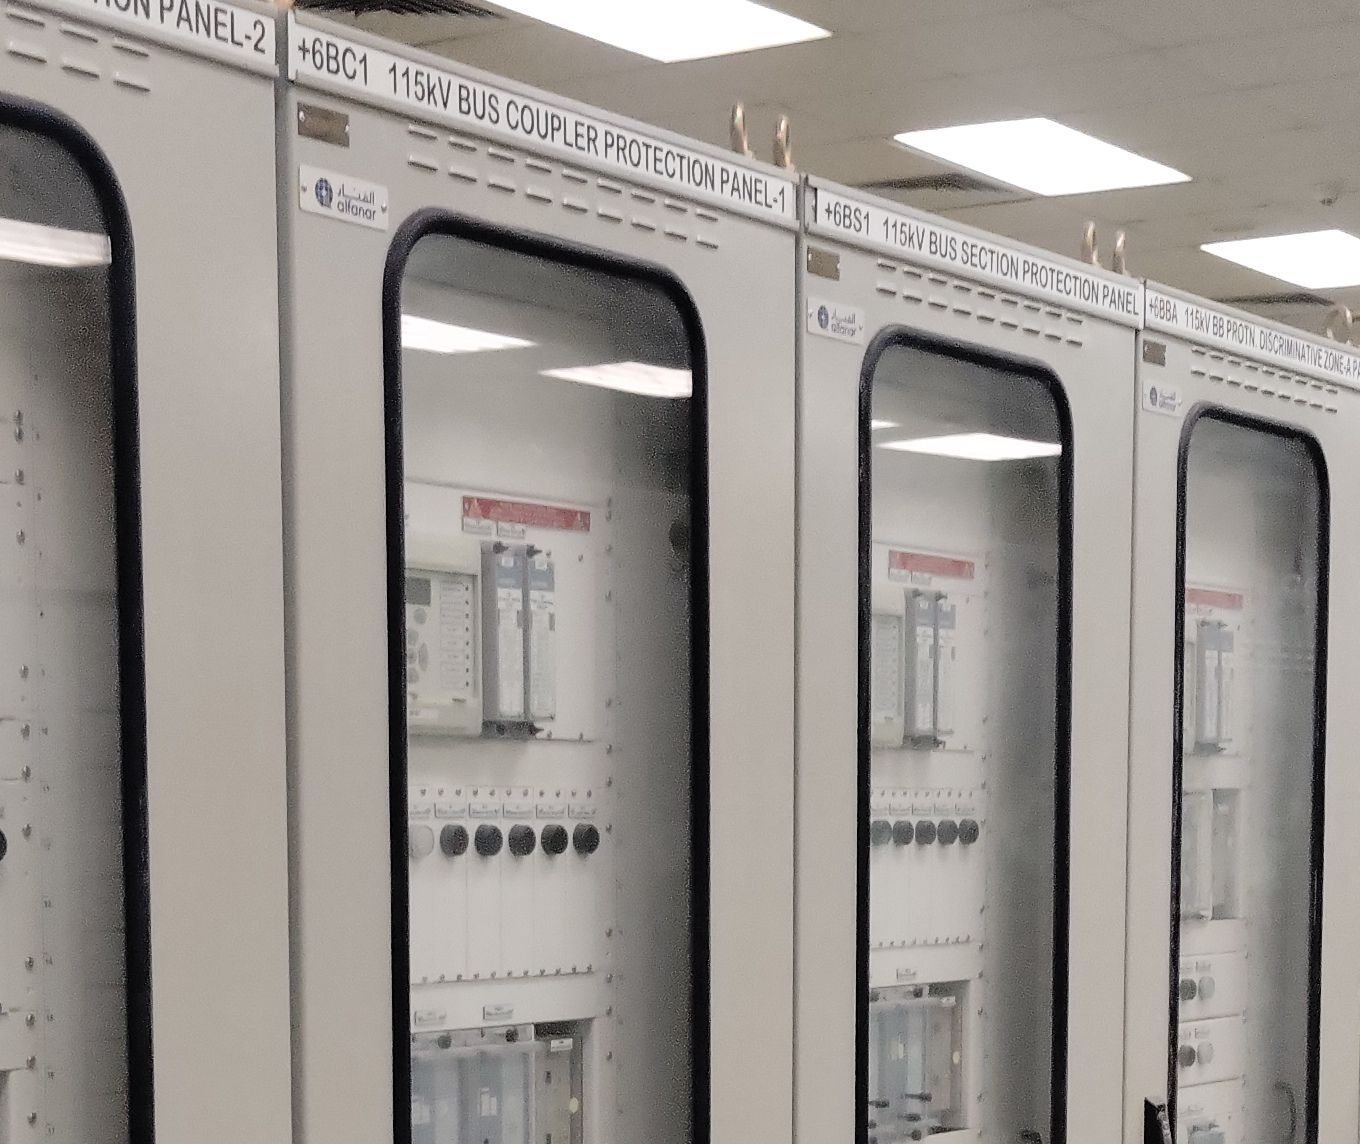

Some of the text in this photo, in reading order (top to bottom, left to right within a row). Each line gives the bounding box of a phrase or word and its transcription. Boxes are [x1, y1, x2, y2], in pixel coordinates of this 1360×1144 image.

[159, 0, 266, 54] PANEL-2
[297, 36, 785, 213] +6BC1 115kV BUS COUPLER PROTECTION PANEL-1
[337, 198, 377, 221] alfanar
[825, 201, 1140, 316] +6BS1 115kV BUS SECTION PROTECTION PANEL
[1259, 330, 1323, 369] DISCRIMINATIVE
